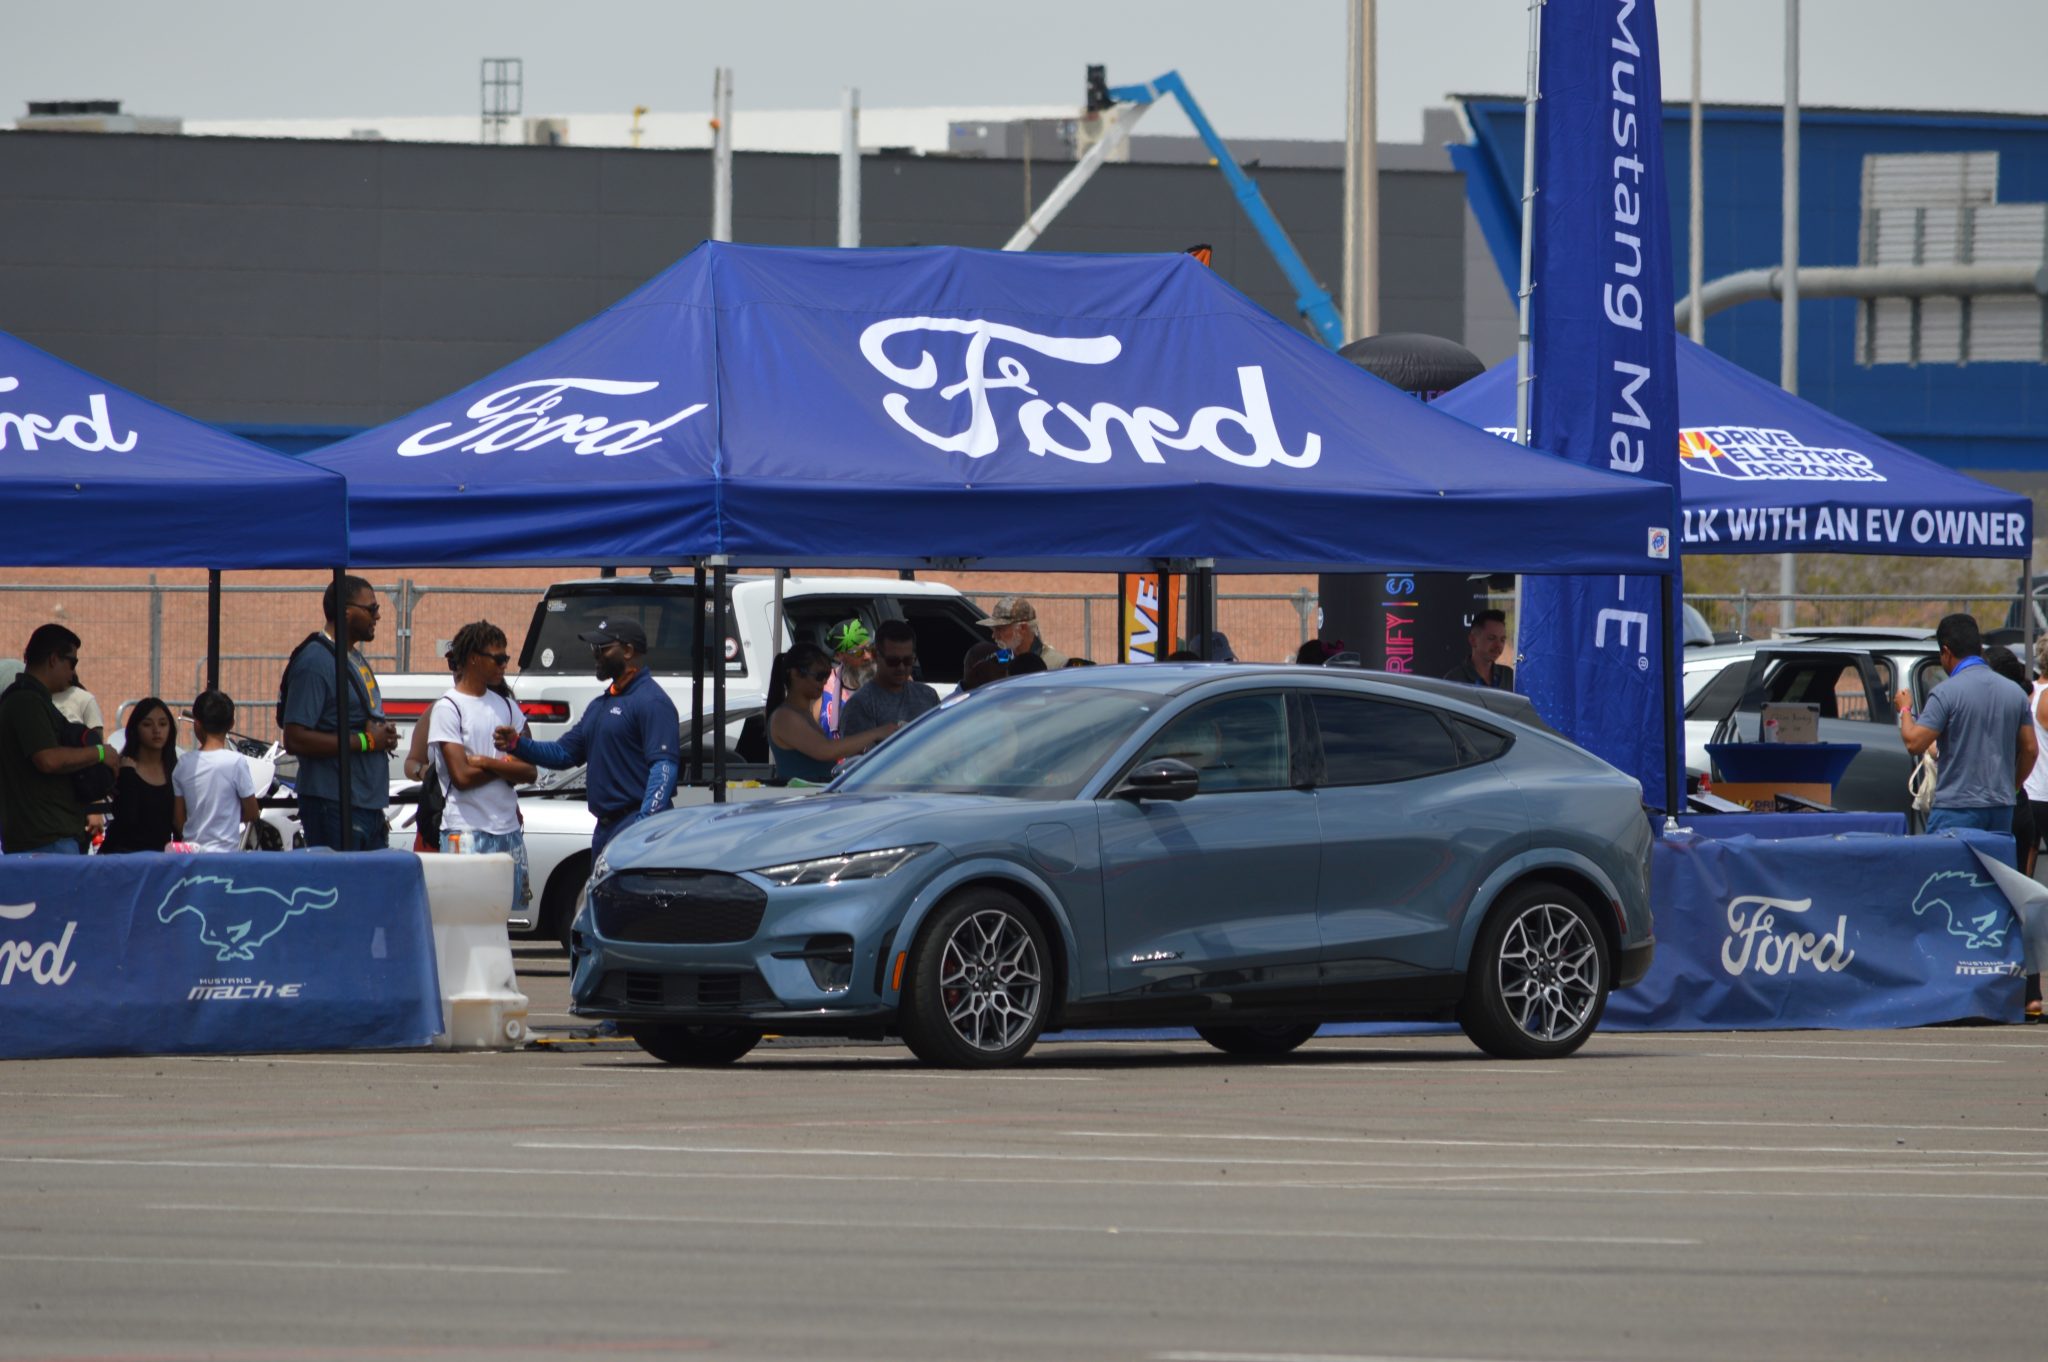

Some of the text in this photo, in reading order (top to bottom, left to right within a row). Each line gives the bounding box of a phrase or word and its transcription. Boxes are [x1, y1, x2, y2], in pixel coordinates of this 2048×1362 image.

[1603, 0, 1645, 331] Mustang
[0, 377, 138, 452] rd
[397, 377, 709, 457] Ford
[860, 316, 1321, 468] Ford
[1705, 430, 1799, 447] DRIVE
[1729, 447, 1867, 467] ELECTRIC
[1745, 463, 1876, 478] ARIZONA
[1681, 507, 2025, 546] LK WITH AN EV OWNER
[0, 902, 77, 985] rd
[1721, 895, 1855, 976] Ford
[199, 977, 252, 985] MUSTANG
